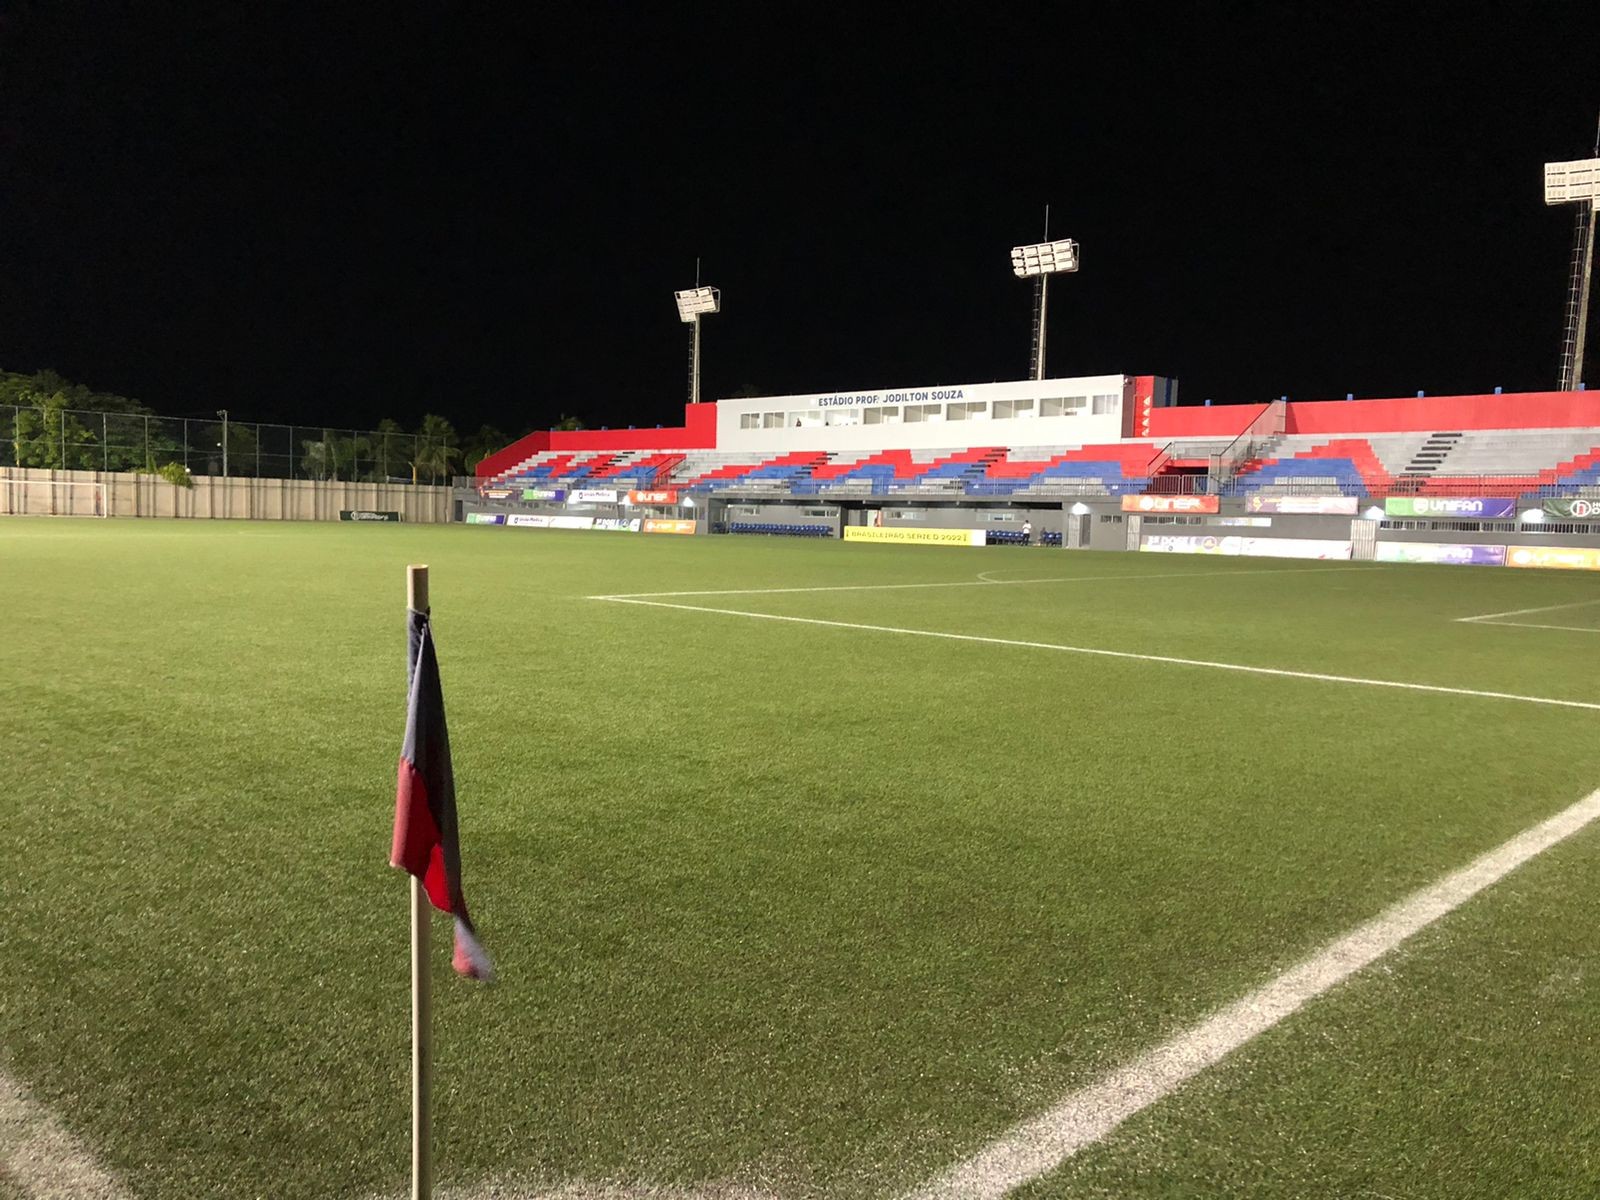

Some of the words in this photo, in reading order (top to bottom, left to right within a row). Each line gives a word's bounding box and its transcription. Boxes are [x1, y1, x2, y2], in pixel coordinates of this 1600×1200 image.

[818, 394, 853, 407] ESTÁDIO
[883, 391, 928, 403] JODILTON
[931, 389, 964, 401] SOUZA
